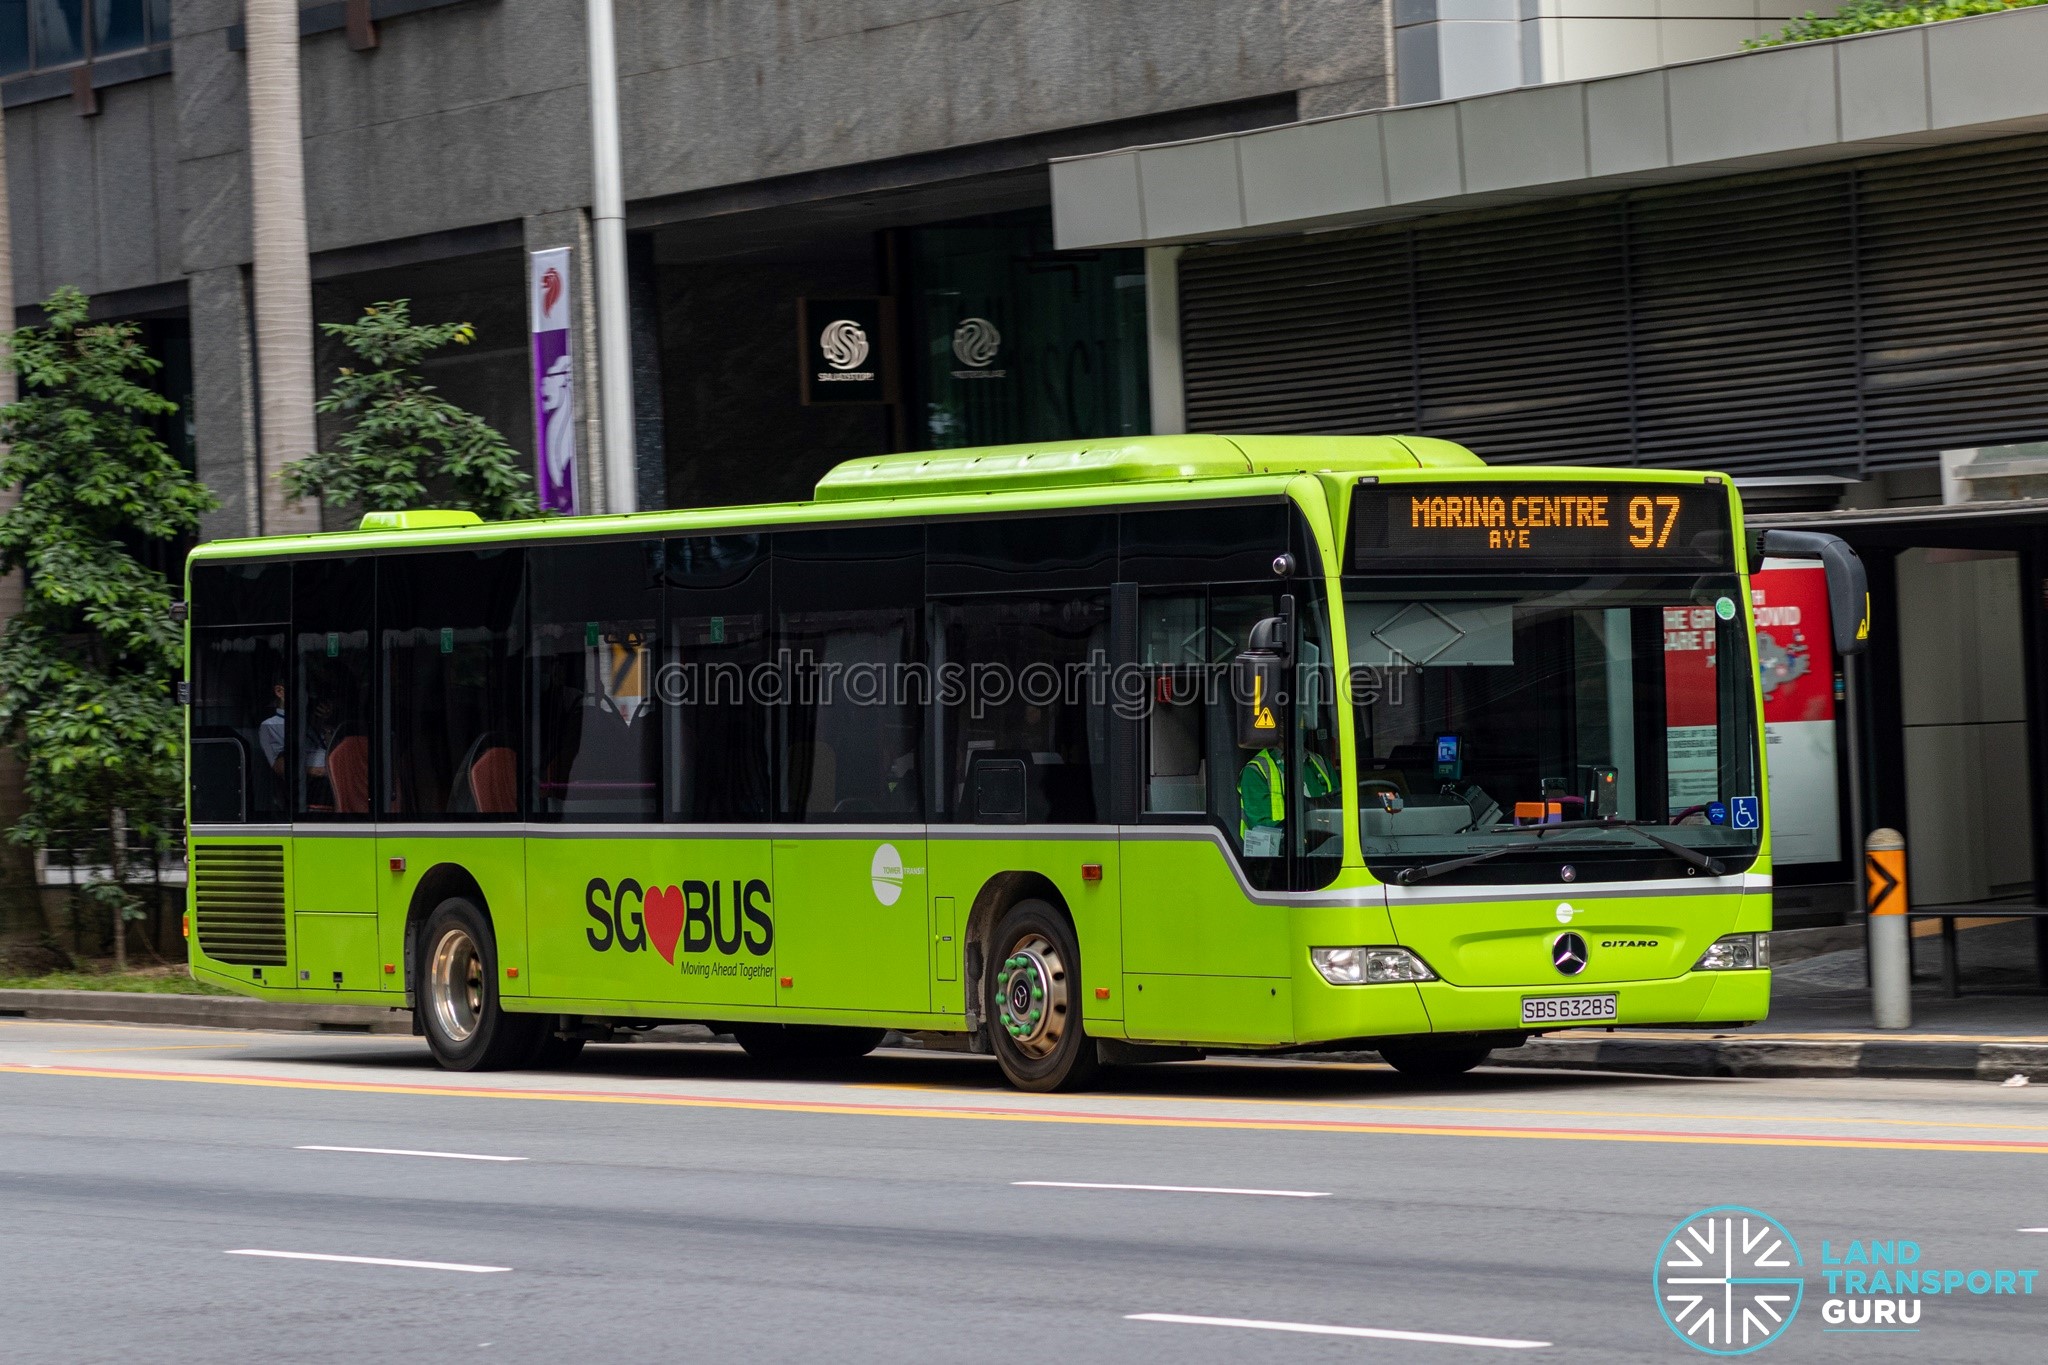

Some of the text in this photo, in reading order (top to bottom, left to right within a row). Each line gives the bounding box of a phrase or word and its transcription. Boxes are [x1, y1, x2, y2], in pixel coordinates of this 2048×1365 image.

[1411, 495, 1681, 549] MARINA CENTRE 97
[1489, 529, 1531, 549] AYE
[1601, 940, 1659, 948] CITARO
[681, 961, 774, 980] Moving Ahead Together
[1524, 998, 1615, 1019] SBS6328S
